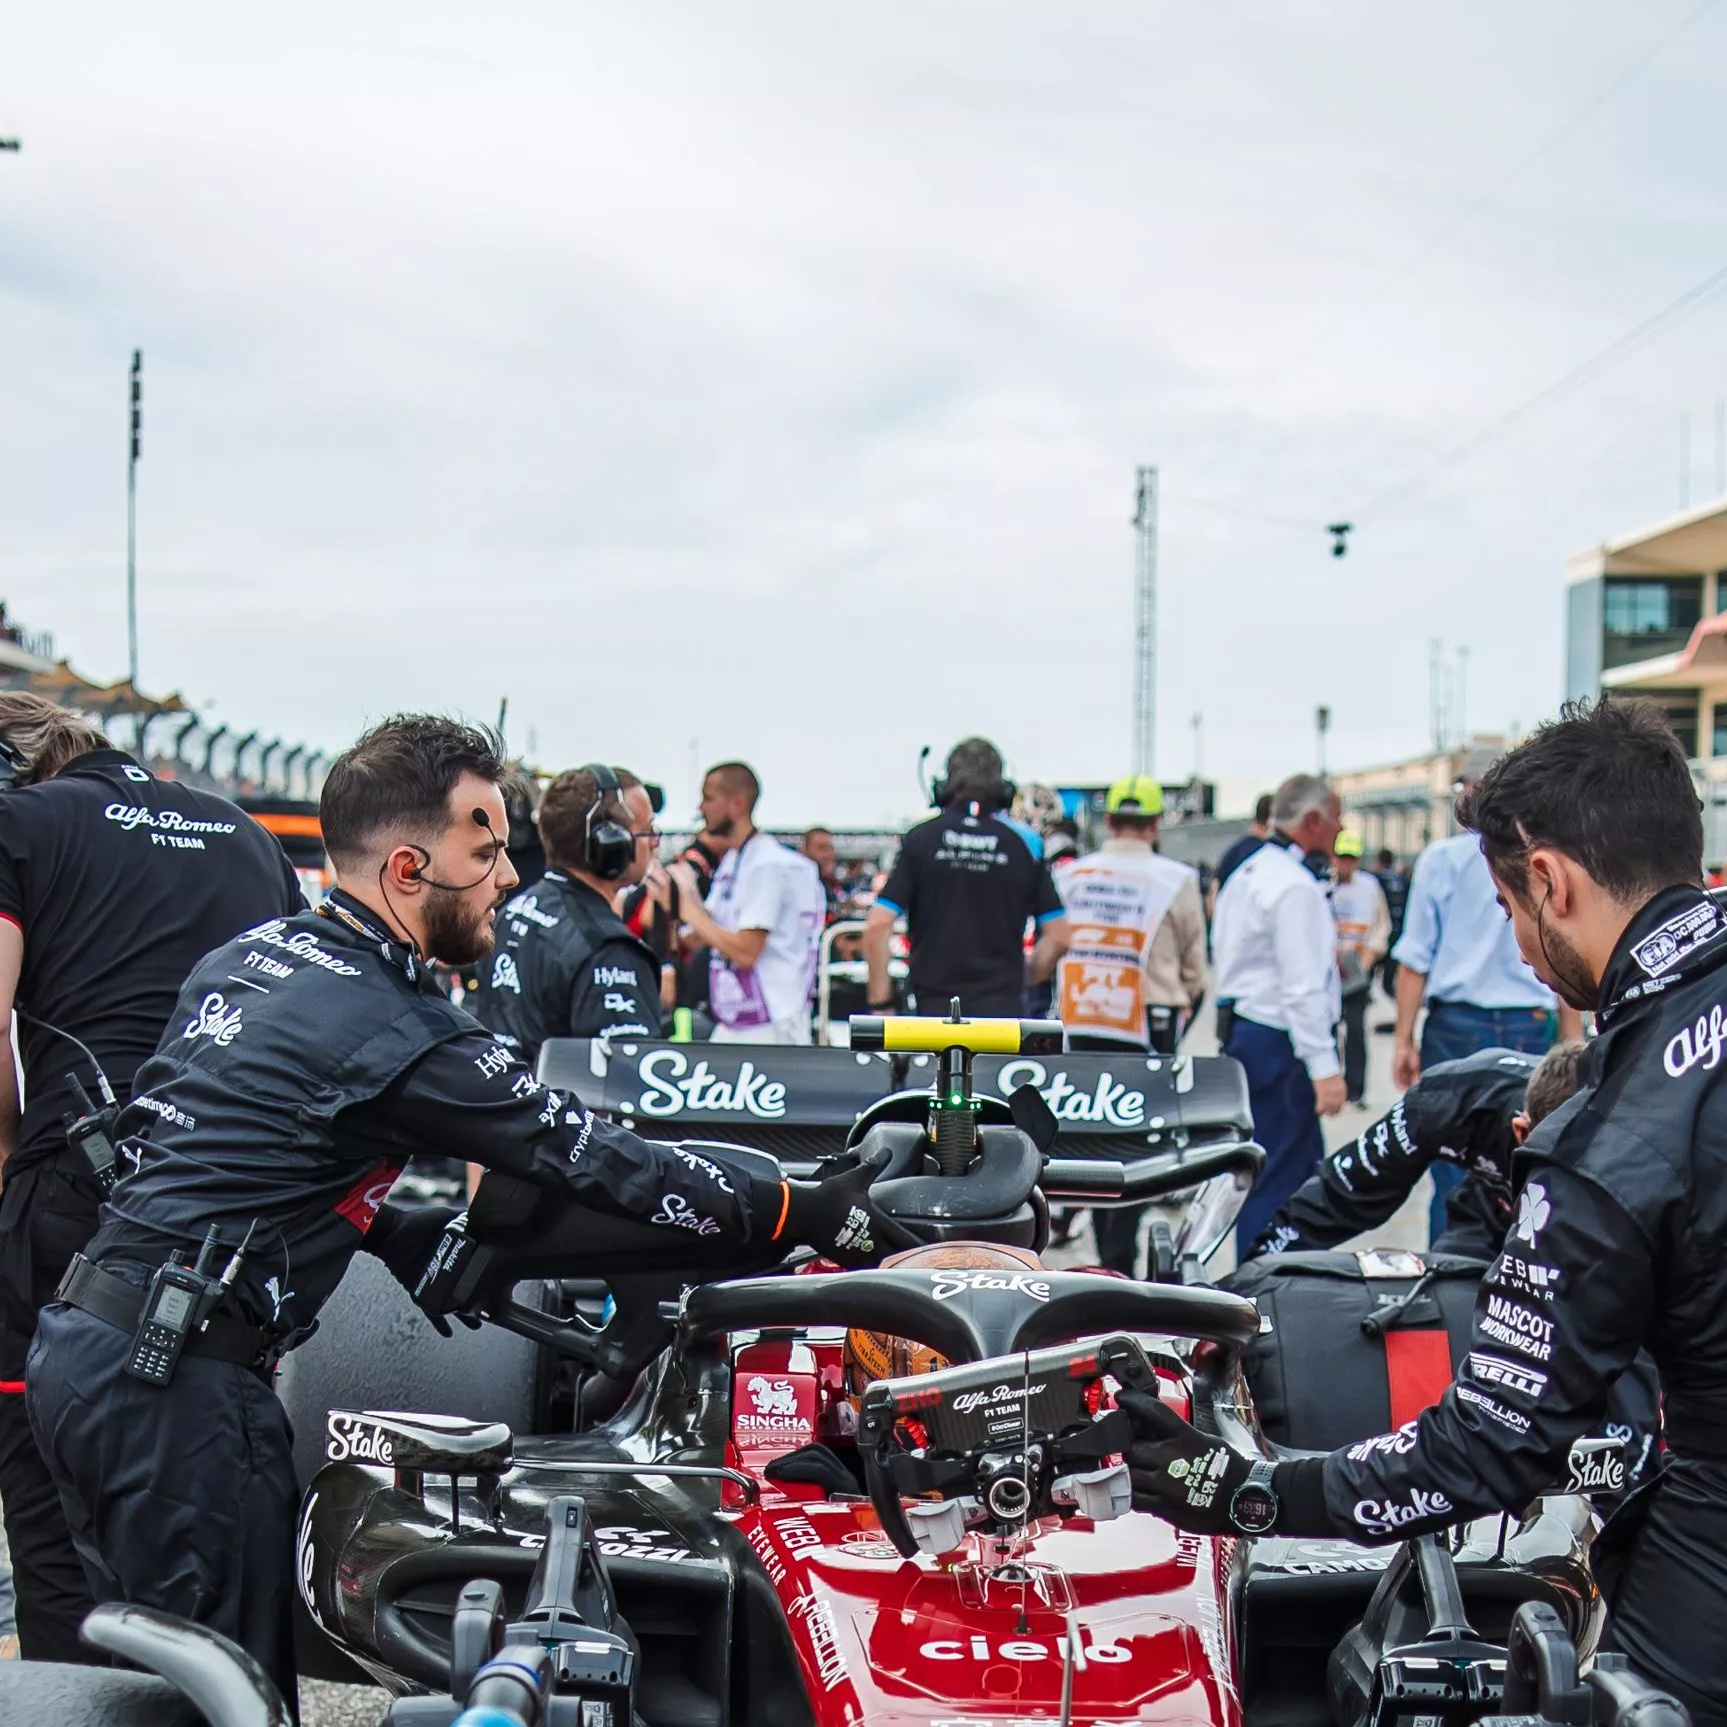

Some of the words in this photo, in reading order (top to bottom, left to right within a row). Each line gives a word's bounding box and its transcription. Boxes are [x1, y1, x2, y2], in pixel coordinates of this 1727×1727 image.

[105, 802, 158, 831] Alfa
[159, 809, 236, 835] Romeo
[151, 833, 168, 847] F1
[171, 836, 205, 851] TEAM
[244, 949, 262, 969] F1
[261, 956, 294, 980] TEAM
[279, 931, 362, 977] Romeo
[183, 991, 244, 1048] Stake
[636, 1048, 788, 1118] Stake
[995, 1058, 1147, 1128] Stake
[650, 1192, 723, 1237] Stake
[928, 1270, 1052, 1303] Stake
[1479, 1317, 1552, 1362] WORKWEAR
[1488, 1294, 1555, 1343] MASCOT
[952, 1387, 999, 1414] Alfa
[996, 1383, 1047, 1404] Romeo
[984, 1407, 995, 1418] F1
[995, 1404, 1021, 1417] TEAM
[327, 1412, 396, 1466] Stake
[736, 1414, 811, 1430] SINGHA
[1563, 1449, 1626, 1494] Stake
[773, 1515, 822, 1550] WEB
[1353, 1487, 1452, 1537] Stake
[747, 1525, 787, 1587] EYEWEAR
